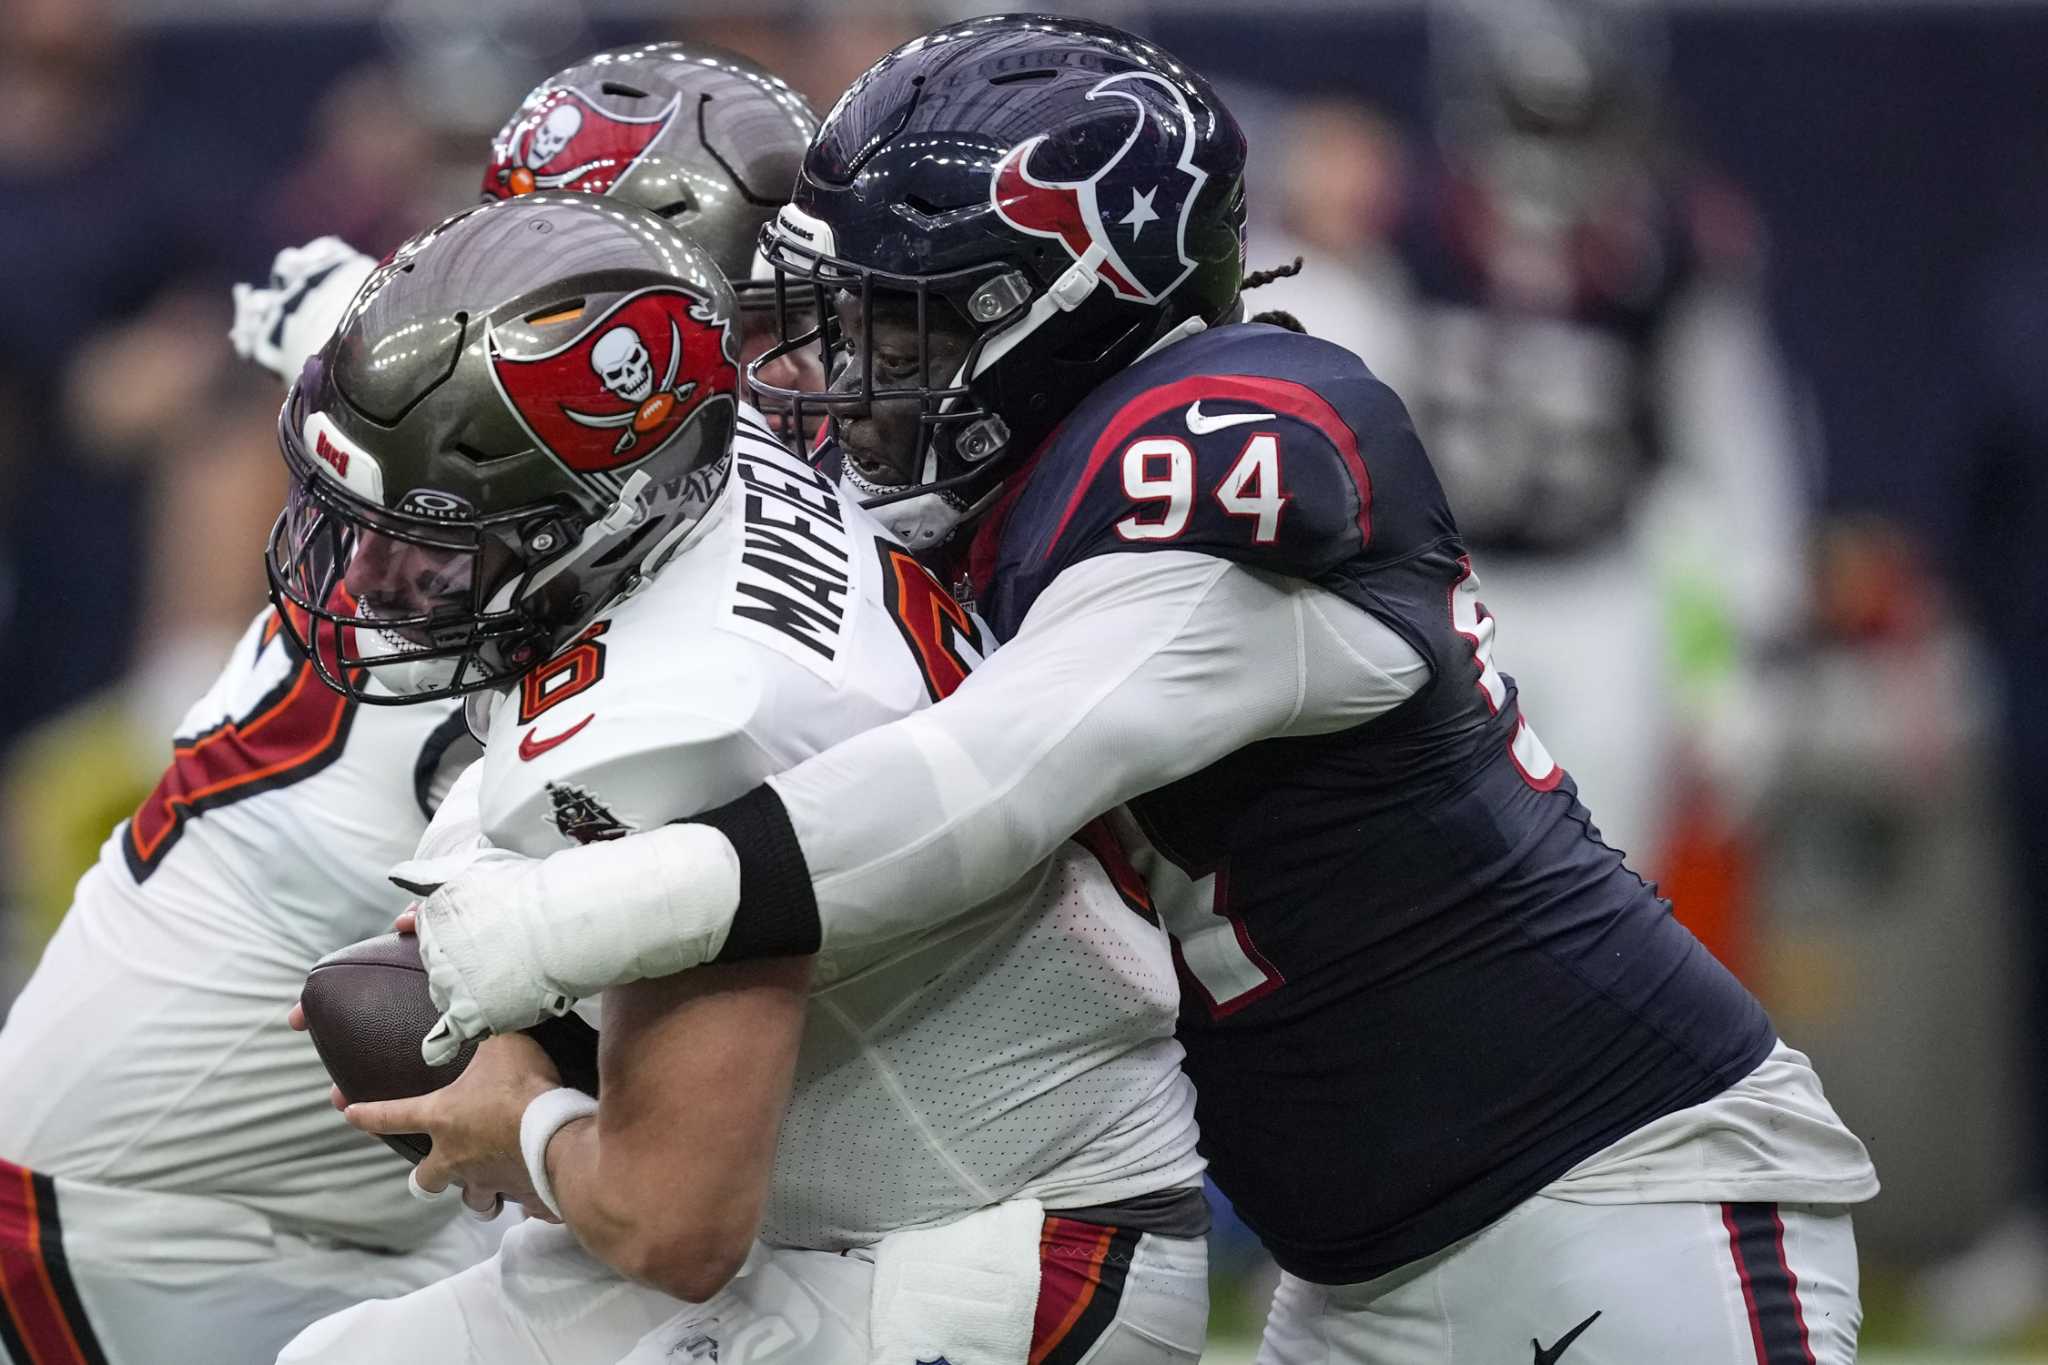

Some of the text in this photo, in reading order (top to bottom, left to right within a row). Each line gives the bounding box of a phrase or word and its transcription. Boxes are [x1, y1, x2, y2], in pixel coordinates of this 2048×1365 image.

[404, 504, 468, 519] OAKLEY
[1114, 431, 1292, 545] 94
[518, 619, 612, 726] 6
